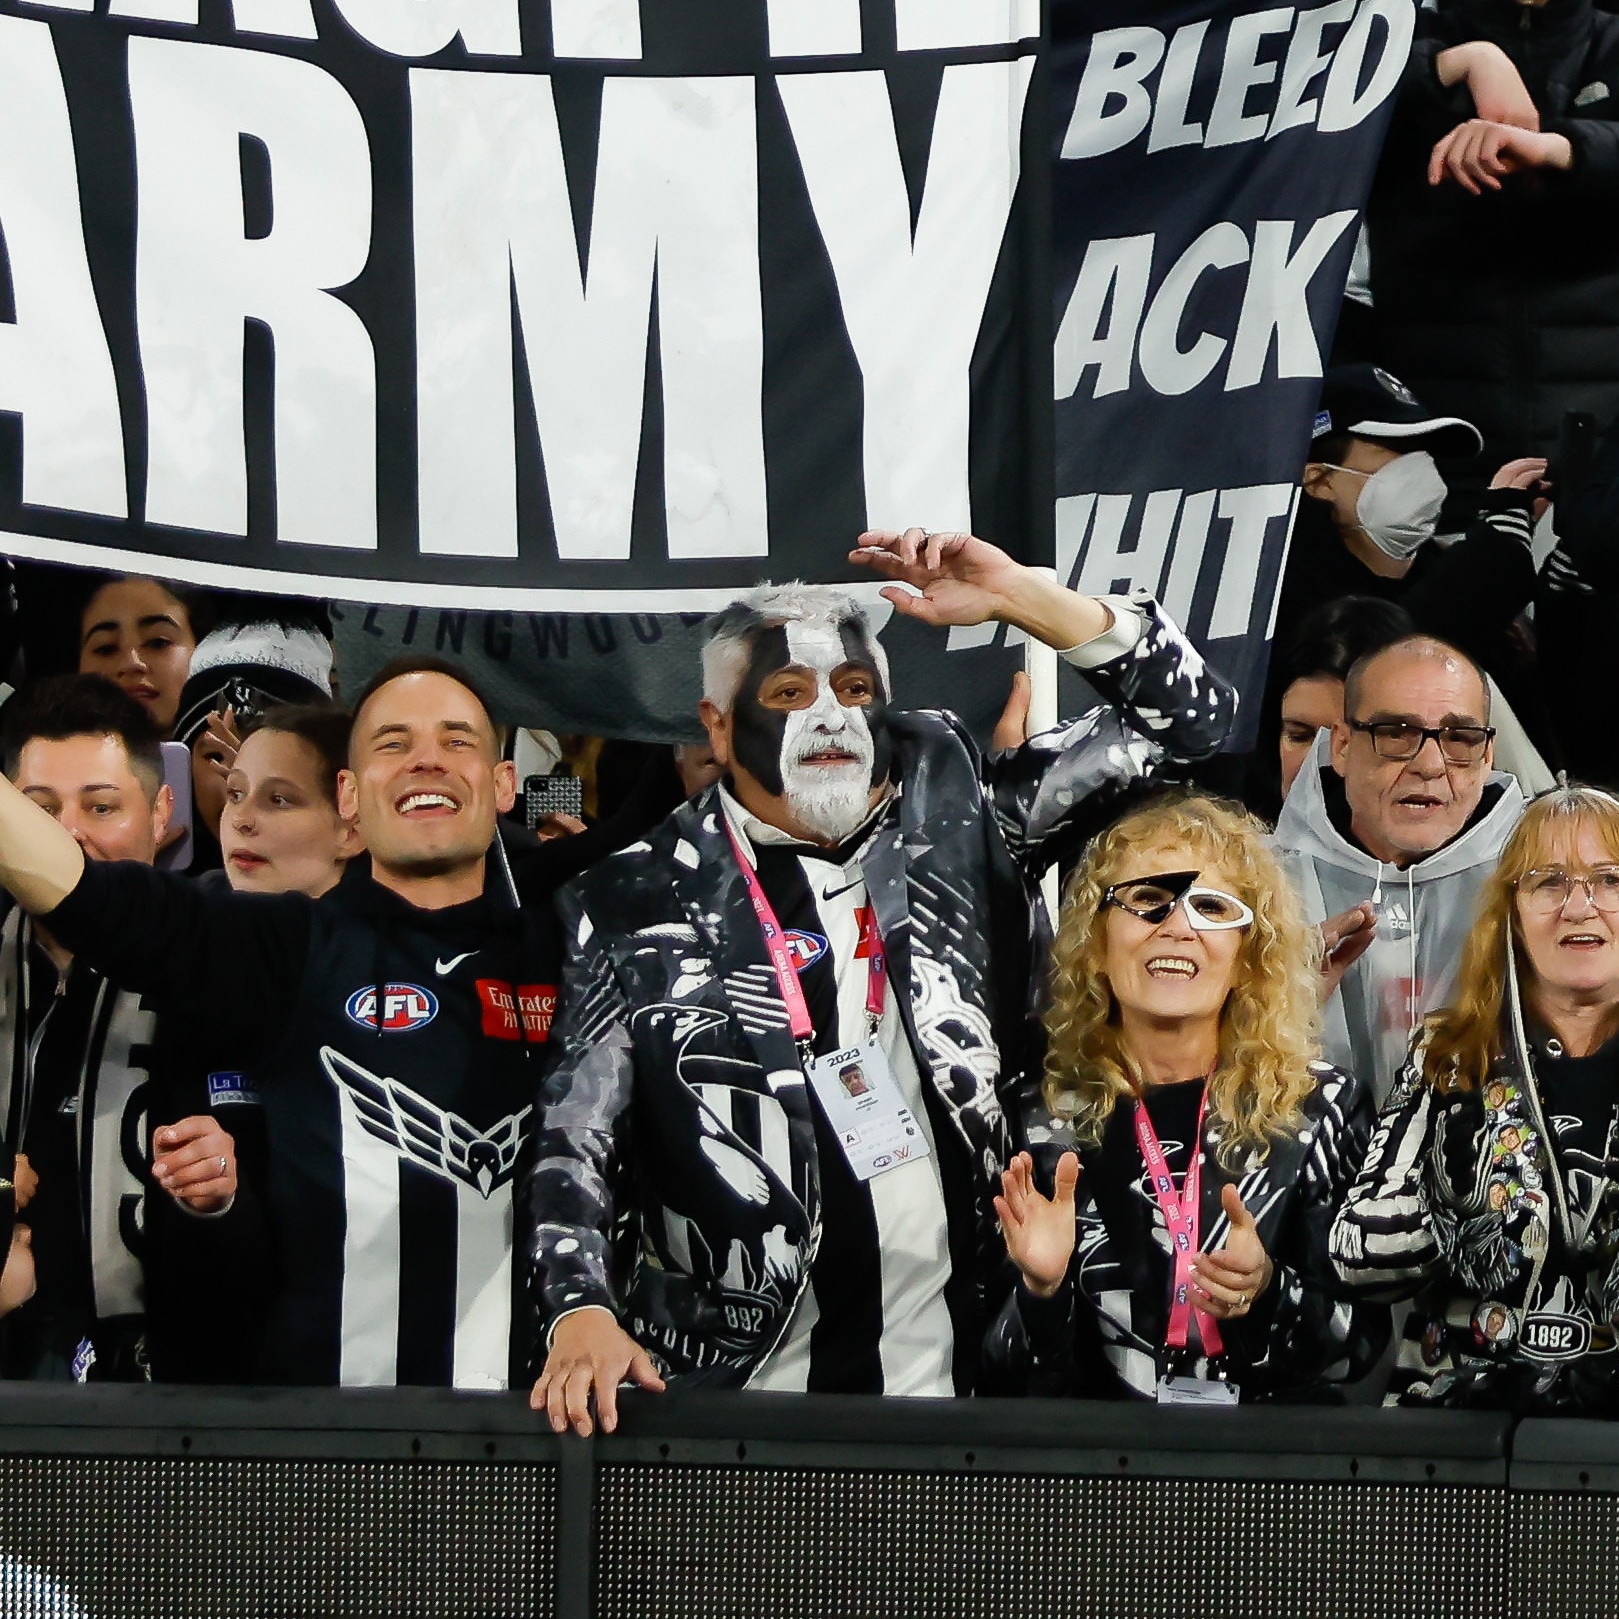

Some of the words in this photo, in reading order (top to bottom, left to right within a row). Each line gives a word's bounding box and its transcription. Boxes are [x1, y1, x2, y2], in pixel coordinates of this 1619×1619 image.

[1054, 208, 1360, 400] ACK
[1055, 482, 1302, 641] HIT
[355, 994, 430, 1020] AFL
[488, 985, 557, 1014] Emrate
[827, 1047, 861, 1068] 2023
[846, 1133, 856, 1143] A
[723, 1304, 764, 1333] 892
[1526, 1324, 1574, 1348] 1892
